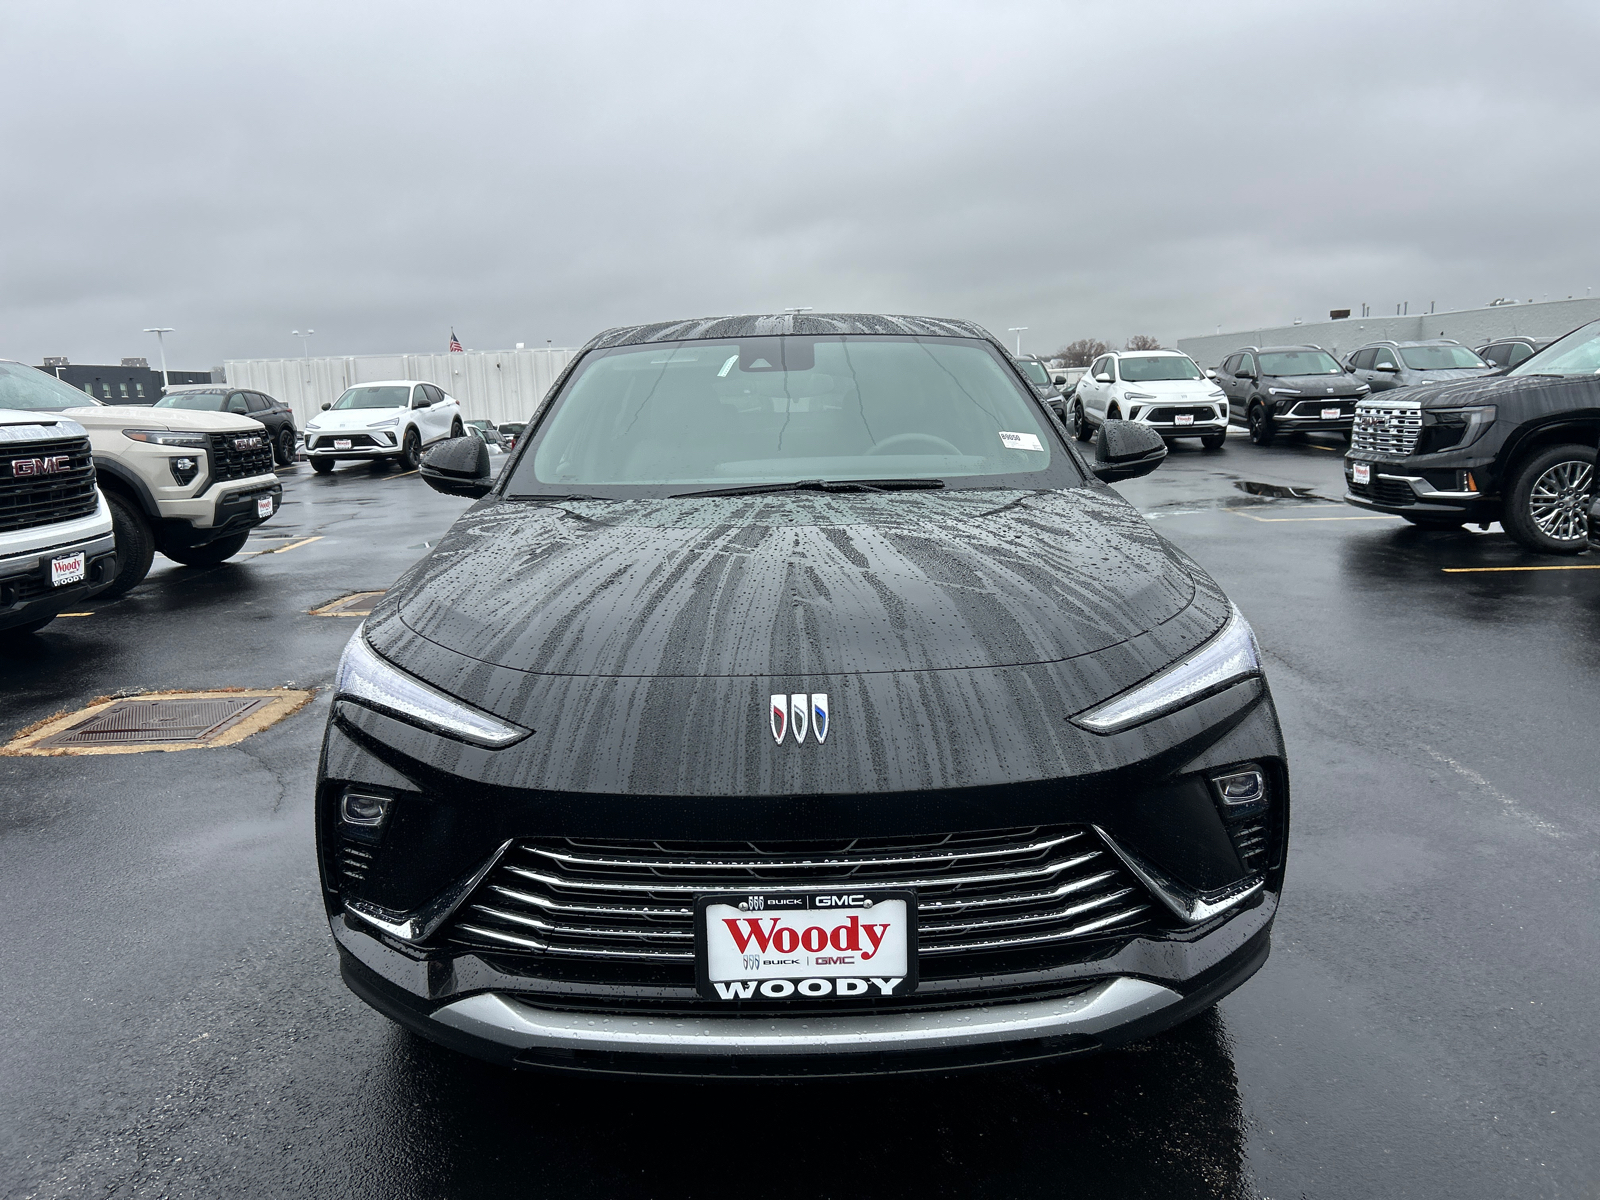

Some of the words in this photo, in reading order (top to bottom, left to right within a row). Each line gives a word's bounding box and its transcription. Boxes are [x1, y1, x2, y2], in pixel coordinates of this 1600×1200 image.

[12, 455, 70, 477] GMC
[53, 558, 82, 573] Woody
[53, 574, 85, 587] WOODY
[815, 895, 865, 907] GMC
[721, 915, 891, 960] Woody
[815, 956, 855, 965] GMC
[713, 977, 904, 1000] WOODY
